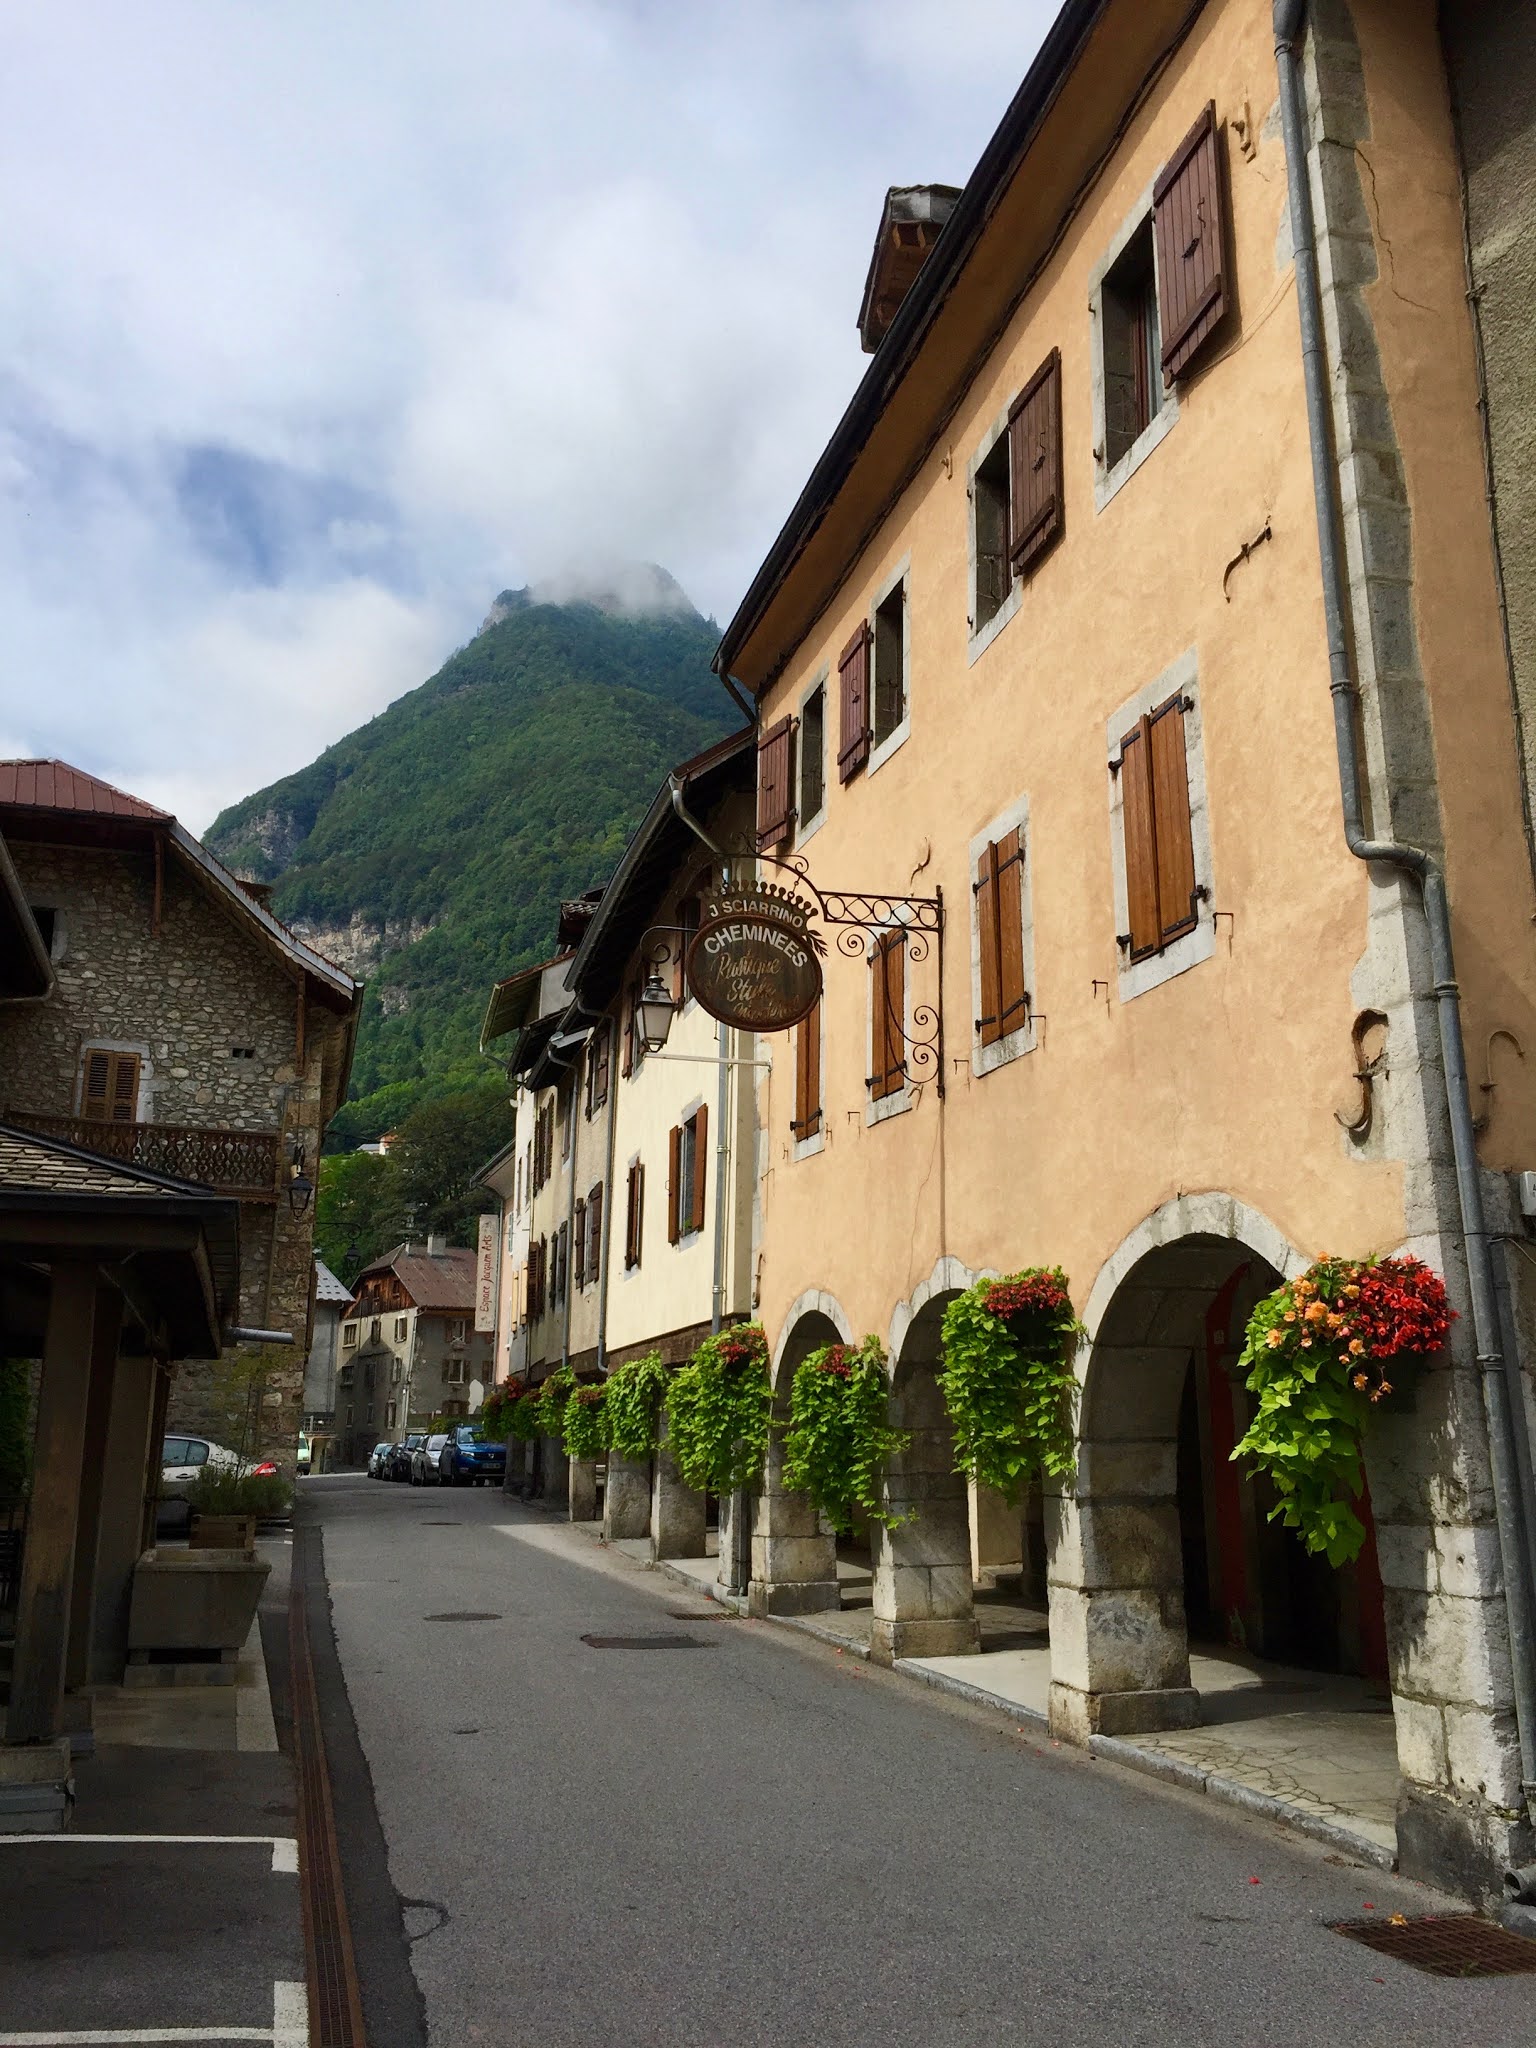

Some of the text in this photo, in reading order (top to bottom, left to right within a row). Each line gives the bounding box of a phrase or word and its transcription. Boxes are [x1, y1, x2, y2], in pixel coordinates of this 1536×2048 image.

[709, 899, 804, 929] J SCIARRINO
[704, 924, 808, 968] CHEMINEES
[481, 1234, 493, 1251] Arts
[479, 1286, 493, 1313] Espace
